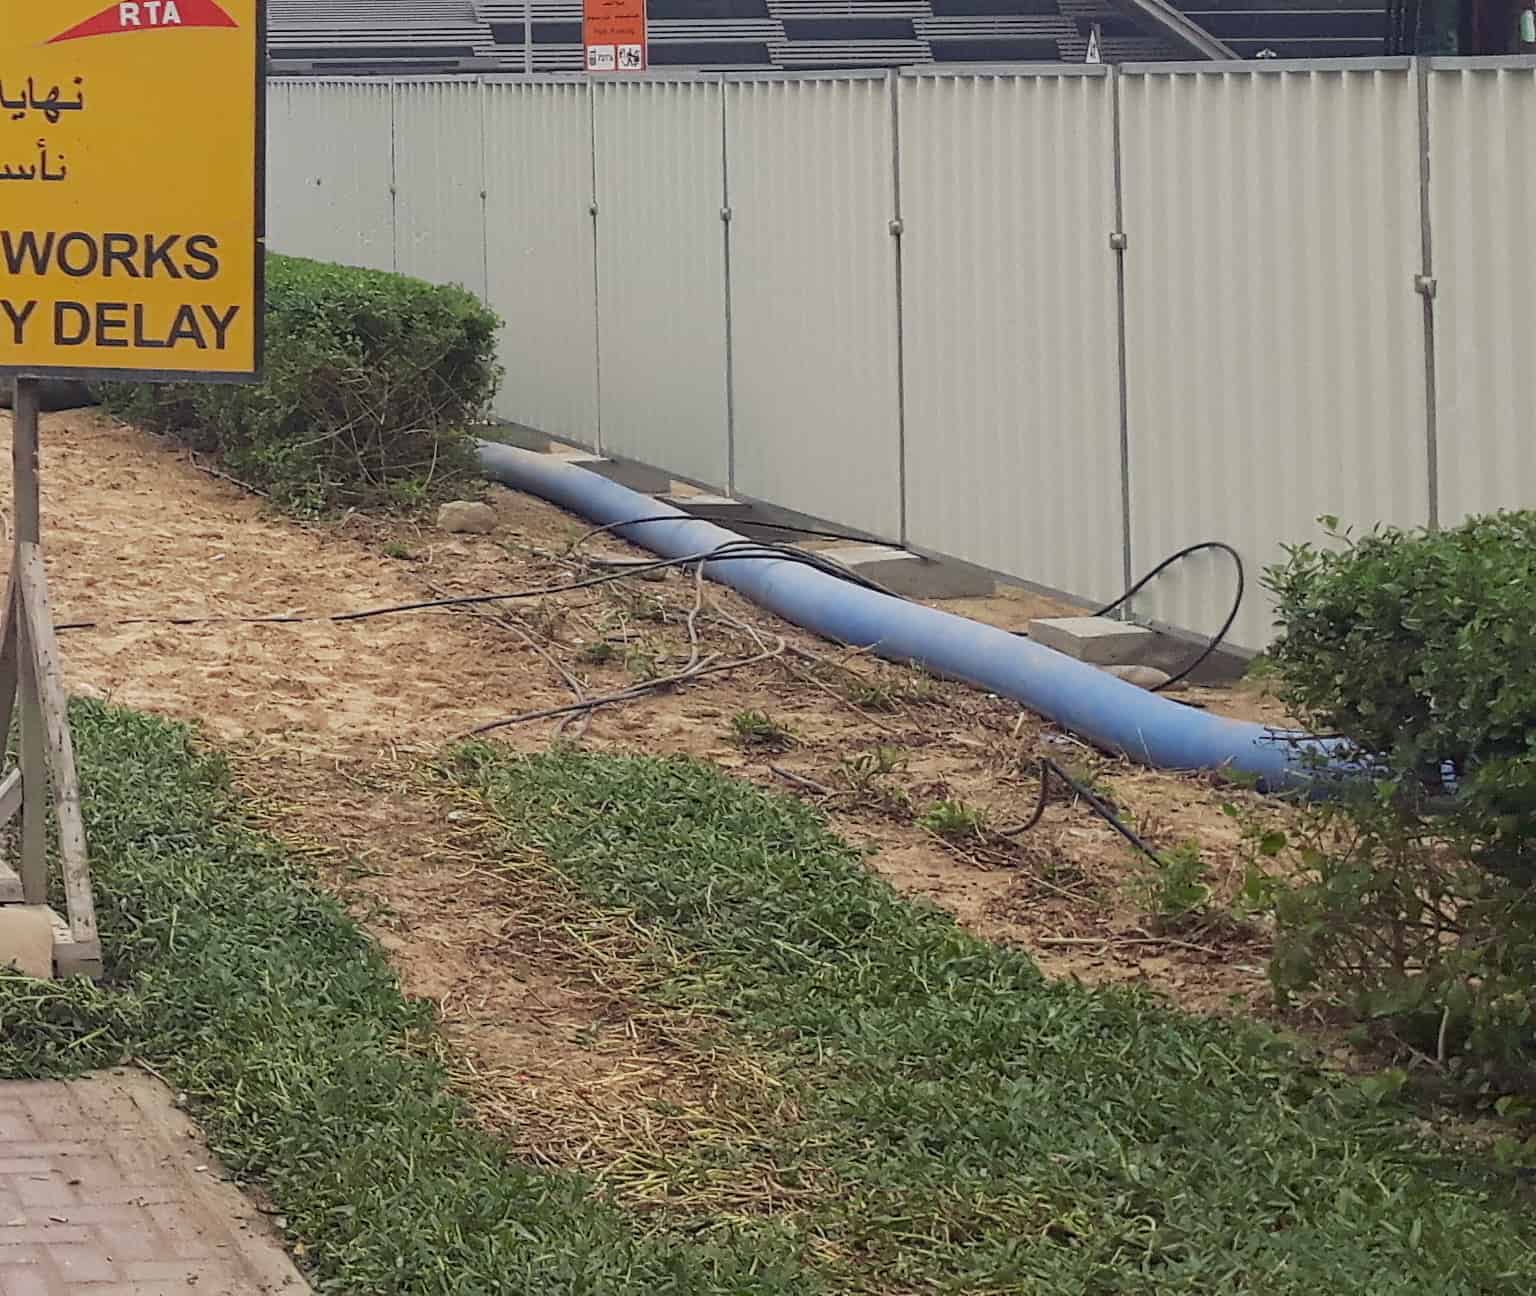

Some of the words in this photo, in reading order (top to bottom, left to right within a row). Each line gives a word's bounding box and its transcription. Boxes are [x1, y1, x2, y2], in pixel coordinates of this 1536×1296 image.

[119, 0, 181, 27] RTA
[0, 231, 219, 280] WORKS
[54, 302, 240, 350] DELAY
